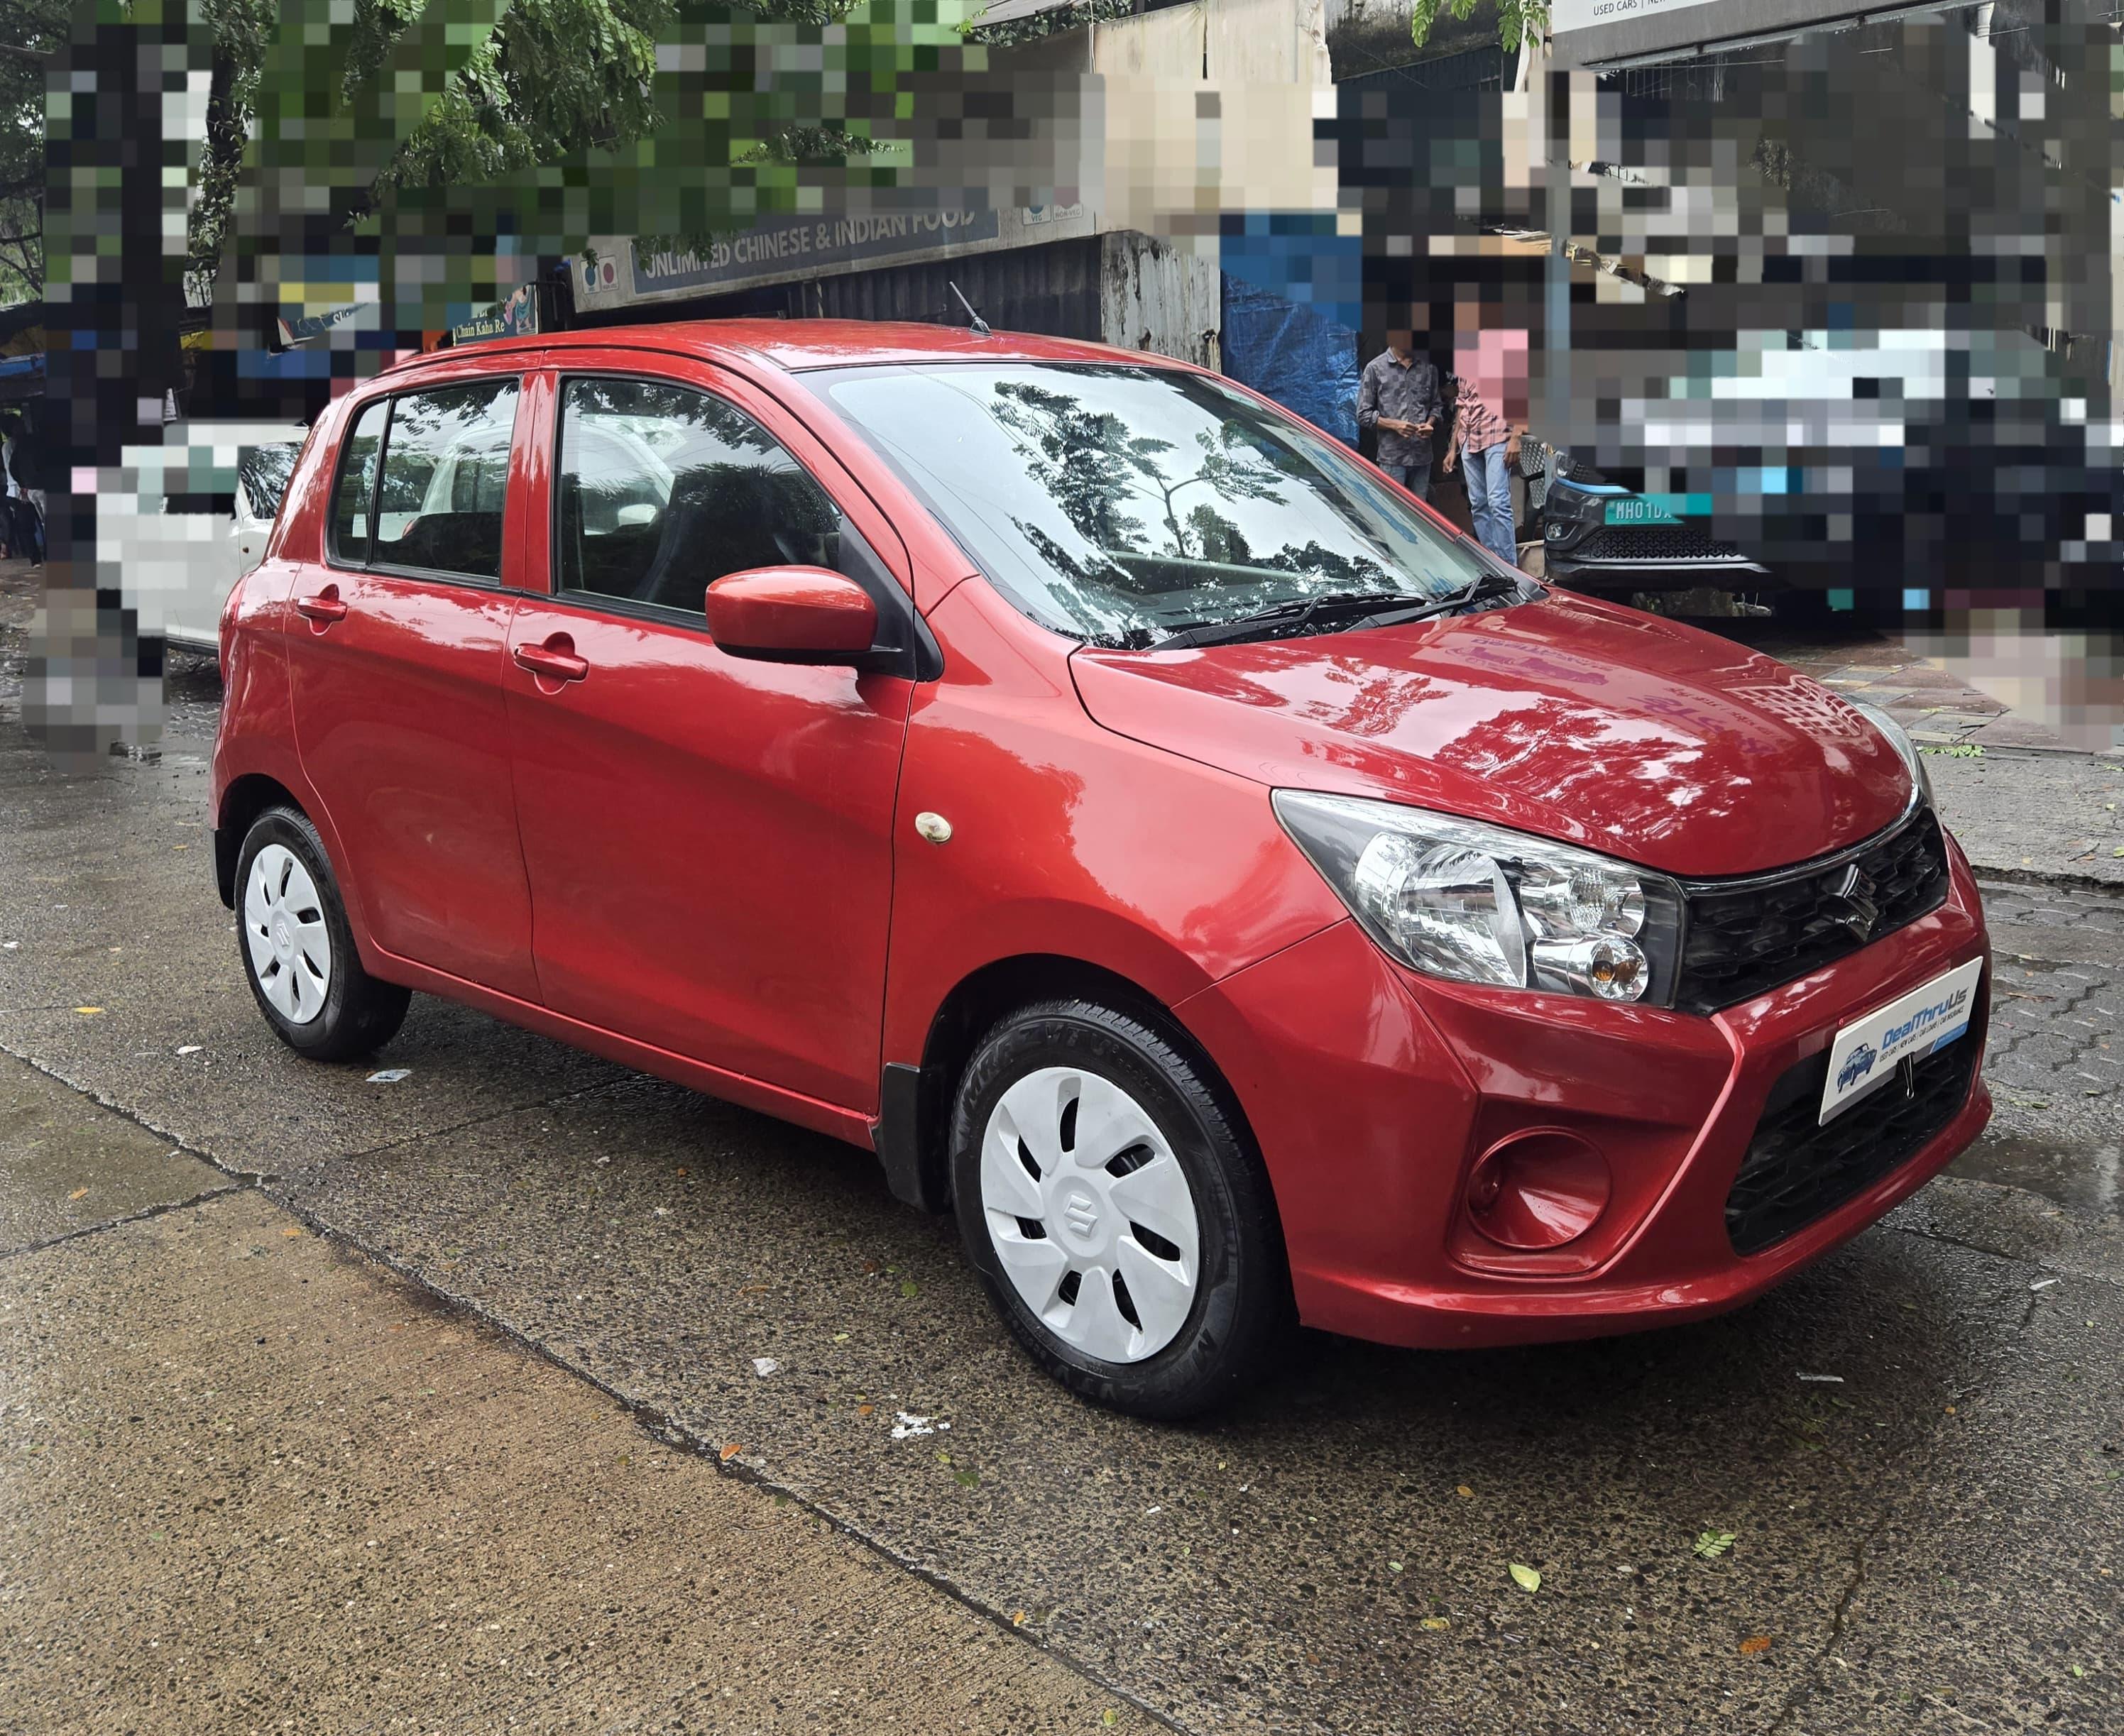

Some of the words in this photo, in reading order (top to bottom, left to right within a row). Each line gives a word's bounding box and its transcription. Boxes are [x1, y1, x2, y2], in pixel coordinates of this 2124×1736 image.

[1594, 3, 1614, 16] USED
[1616, 0, 1637, 11] CARS
[734, 226, 811, 263] CHINESE
[816, 222, 831, 249] &
[835, 215, 907, 247] INDIAN
[495, 319, 505, 333] Re
